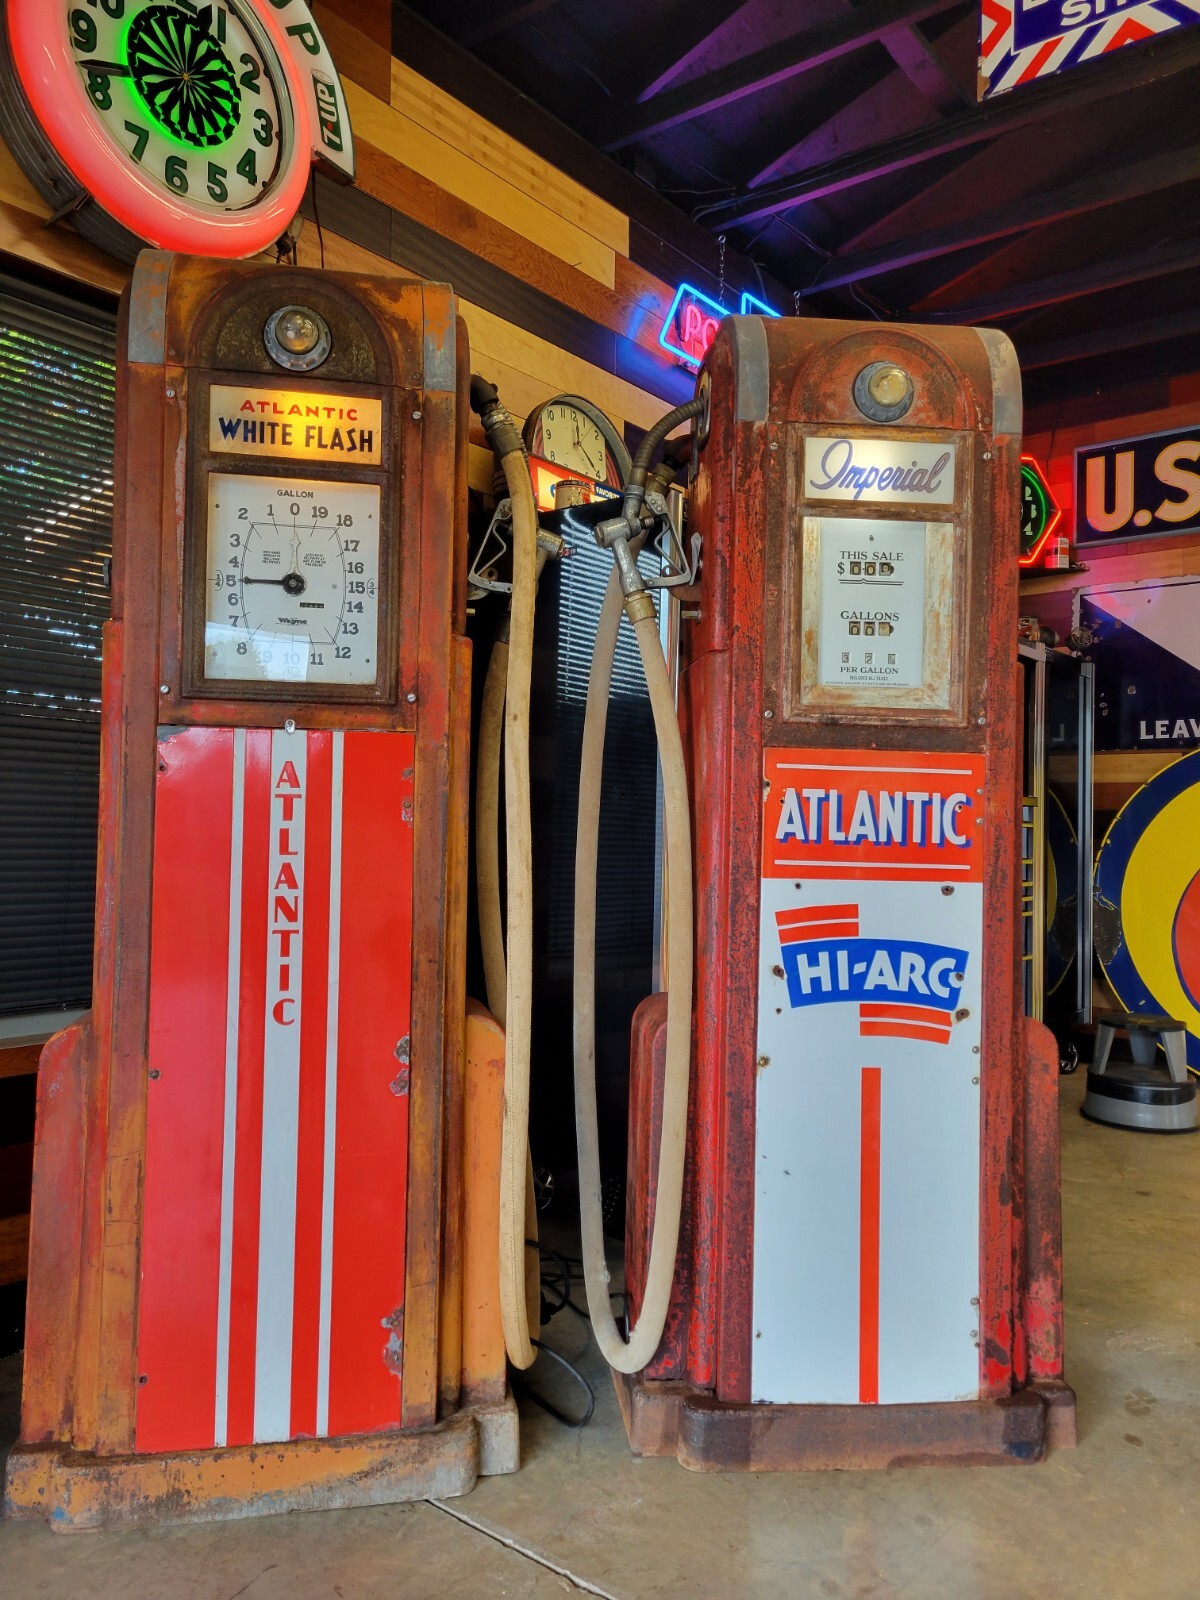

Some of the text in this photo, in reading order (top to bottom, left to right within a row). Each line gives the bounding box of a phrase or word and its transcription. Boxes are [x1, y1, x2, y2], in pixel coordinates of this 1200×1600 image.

[71, 8, 98, 53] 9
[217, 5, 227, 45] 1
[239, 53, 260, 95] 2
[86, 66, 113, 111] 8
[253, 108, 274, 148] 3
[124, 119, 150, 165] 7
[236, 148, 258, 187] 4
[164, 155, 189, 198] 6
[207, 161, 229, 204] 5
[240, 399, 358, 421] ATLANTIC
[218, 417, 373, 453] WHITE FLASH
[809, 439, 951, 500] Imperial
[277, 489, 314, 499] GALLON
[237, 507, 249, 521] 2
[266, 503, 275, 517] 1
[289, 502, 301, 516] 0
[311, 505, 329, 519] 19
[336, 513, 354, 528] 18
[229, 533, 241, 548] 3
[343, 539, 361, 553] 17
[228, 555, 240, 569] 4
[839, 550, 904, 561] THIS SALE
[347, 561, 365, 575] 16
[225, 574, 237, 588] 5
[348, 580, 366, 595] 15
[227, 592, 240, 607] 6
[346, 600, 364, 614] 14
[228, 614, 240, 628] 7
[840, 611, 900, 622] GALLONS
[341, 622, 360, 636] 13
[236, 641, 248, 656] 8
[334, 646, 352, 659] 12
[282, 652, 301, 666] 10
[310, 652, 324, 666] 11
[860, 667, 899, 675] GALLON
[775, 787, 972, 848] ATLANTIC
[272, 760, 302, 1026] ATLANTIC
[796, 949, 958, 999] HI-ARC
